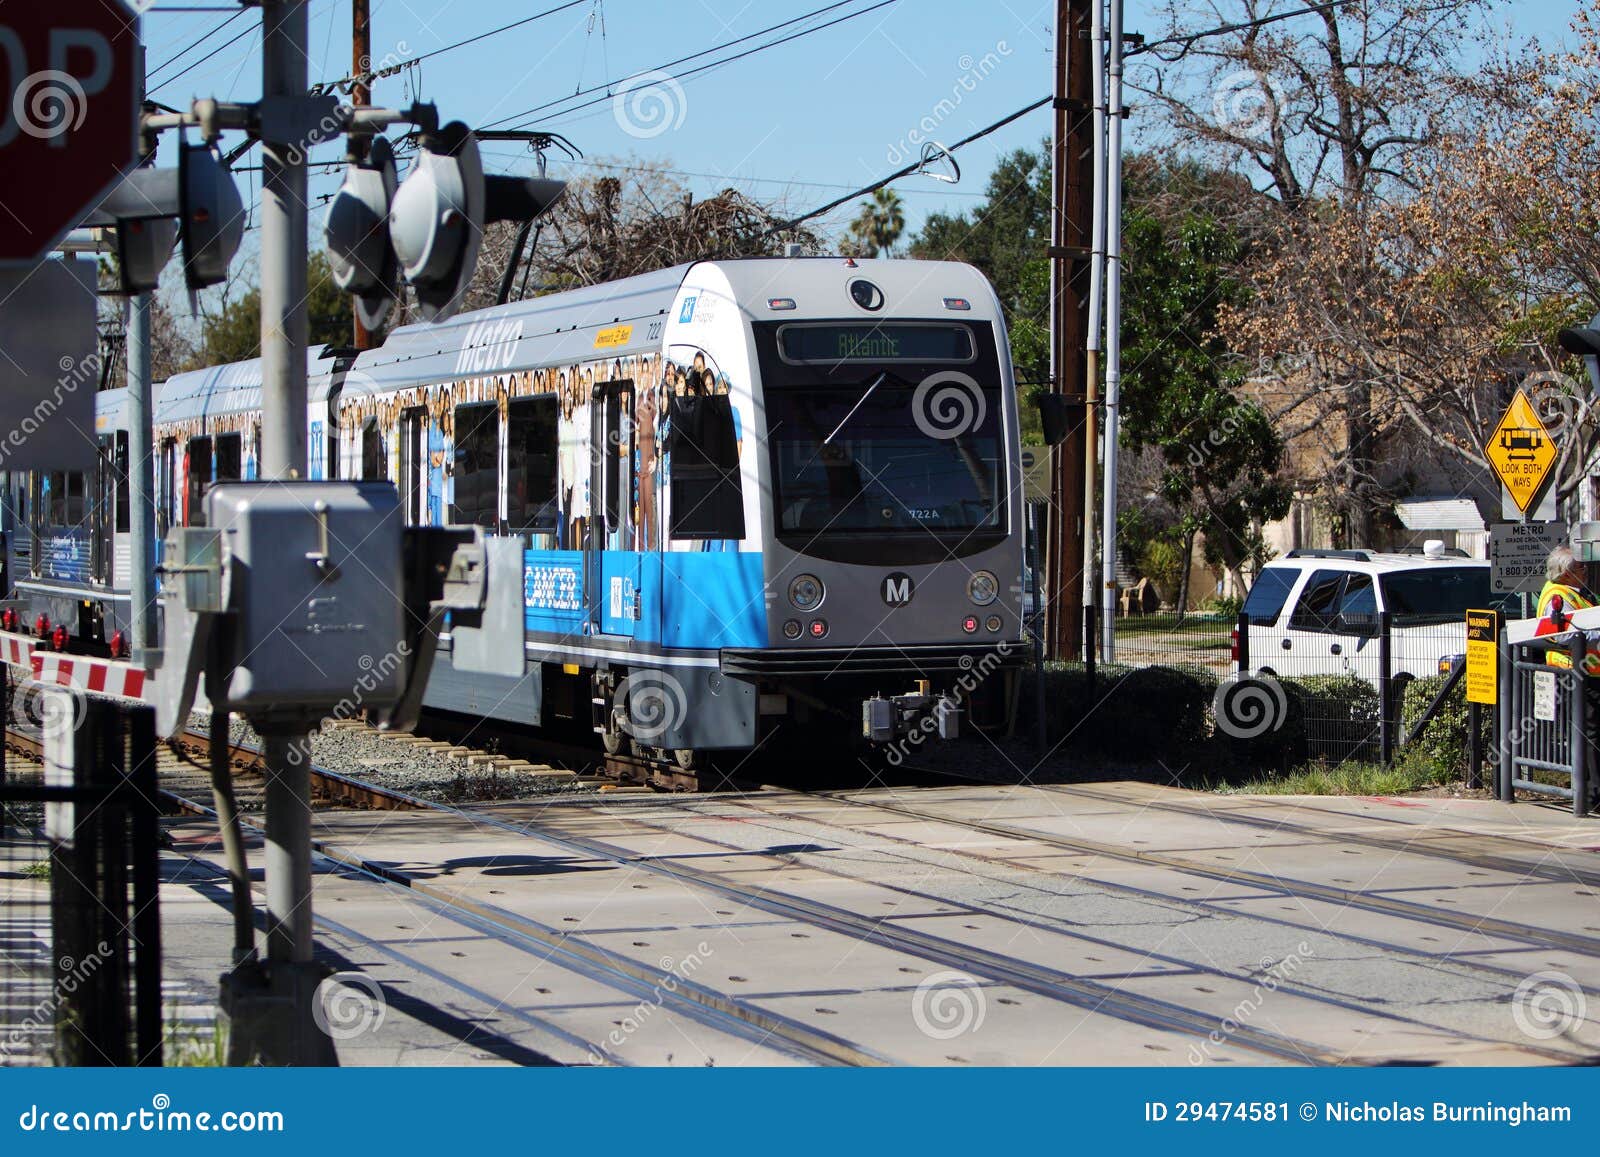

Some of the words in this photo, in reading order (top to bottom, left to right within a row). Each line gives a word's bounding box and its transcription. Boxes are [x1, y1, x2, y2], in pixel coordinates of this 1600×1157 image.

[646, 321, 662, 341] 722
[454, 312, 523, 374] Metro
[839, 333, 899, 357] Atlantic
[1501, 464, 1519, 473] LOOK
[1523, 463, 1542, 473] BOTH
[1513, 477, 1531, 487] WAYS
[909, 509, 939, 519] 722A
[1512, 525, 1544, 535] METRO
[1505, 566, 1521, 575] 800
[886, 578, 909, 602] M
[1468, 617, 1490, 628] WARNING
